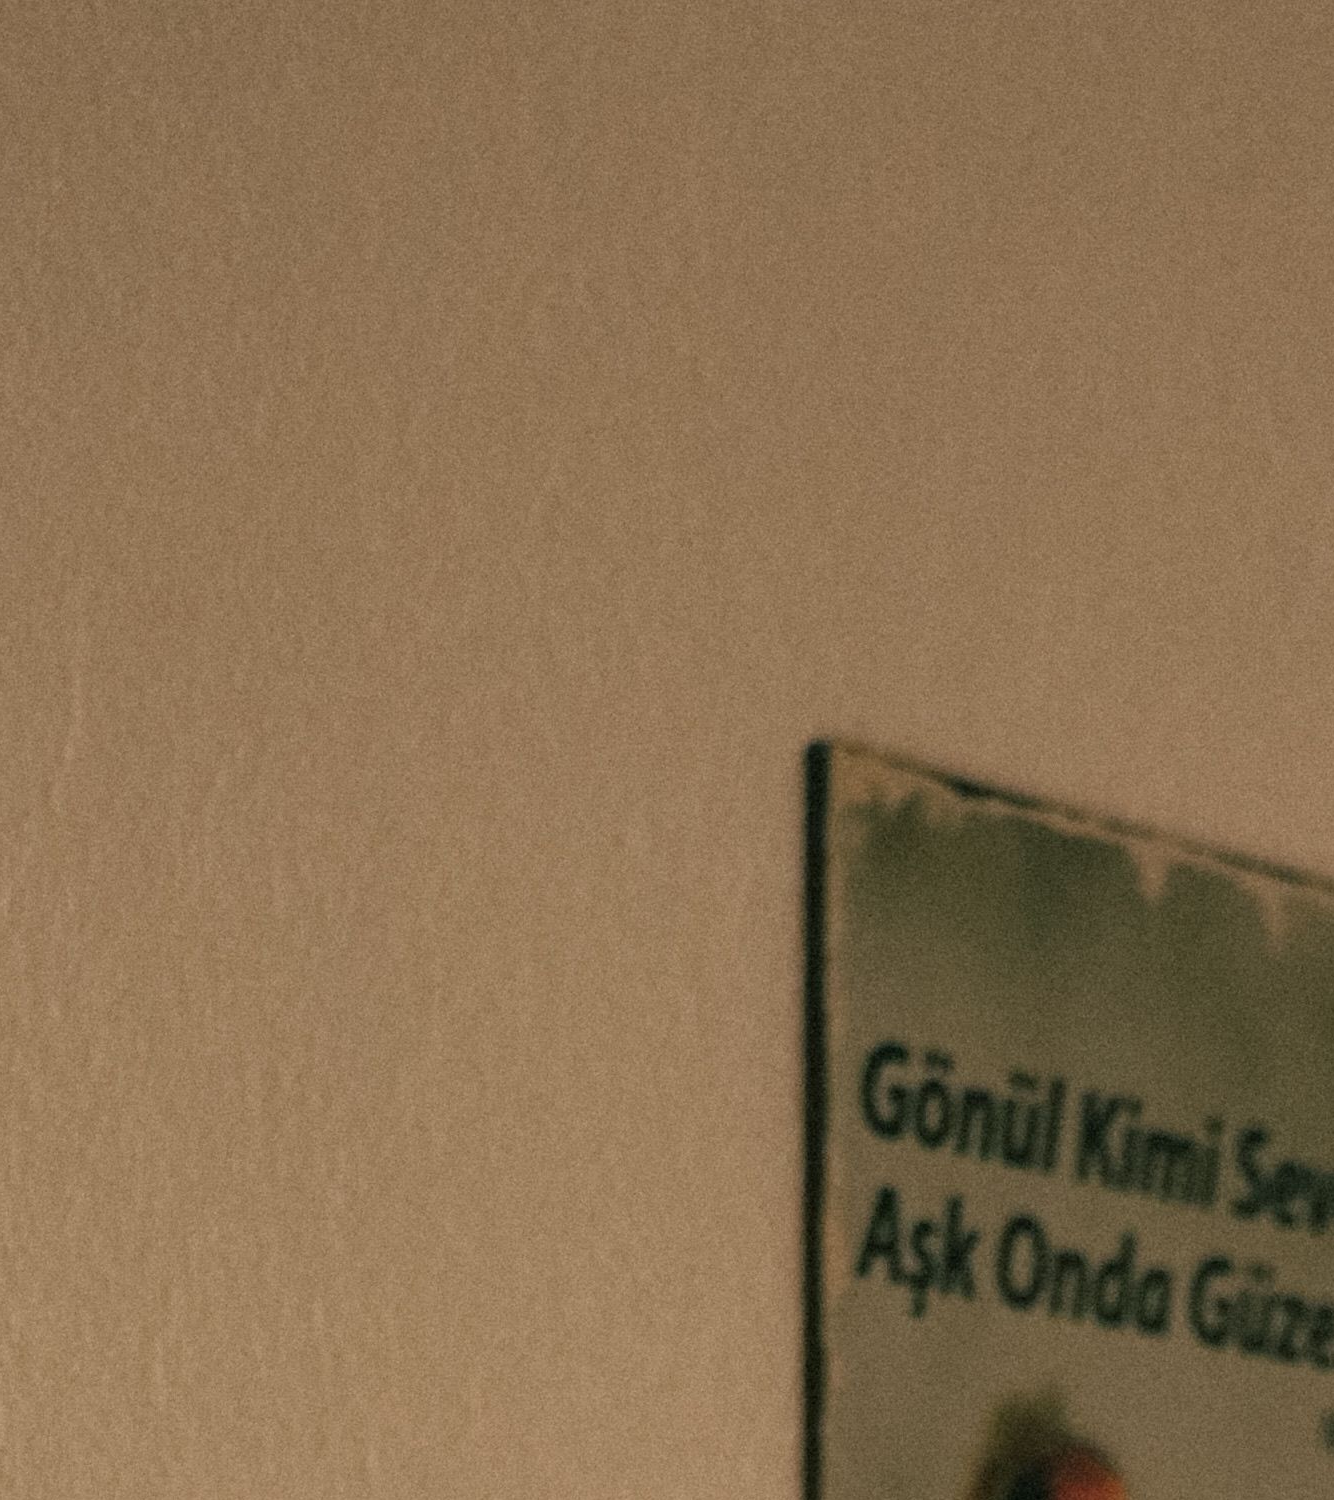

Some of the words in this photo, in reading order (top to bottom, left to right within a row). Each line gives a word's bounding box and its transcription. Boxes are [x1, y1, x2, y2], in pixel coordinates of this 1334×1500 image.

[860, 1040, 1066, 1174] Gönül
[1076, 1090, 1223, 1206] Kimi
[856, 1185, 979, 1319] Aşk
[994, 1214, 1173, 1336] Onda
